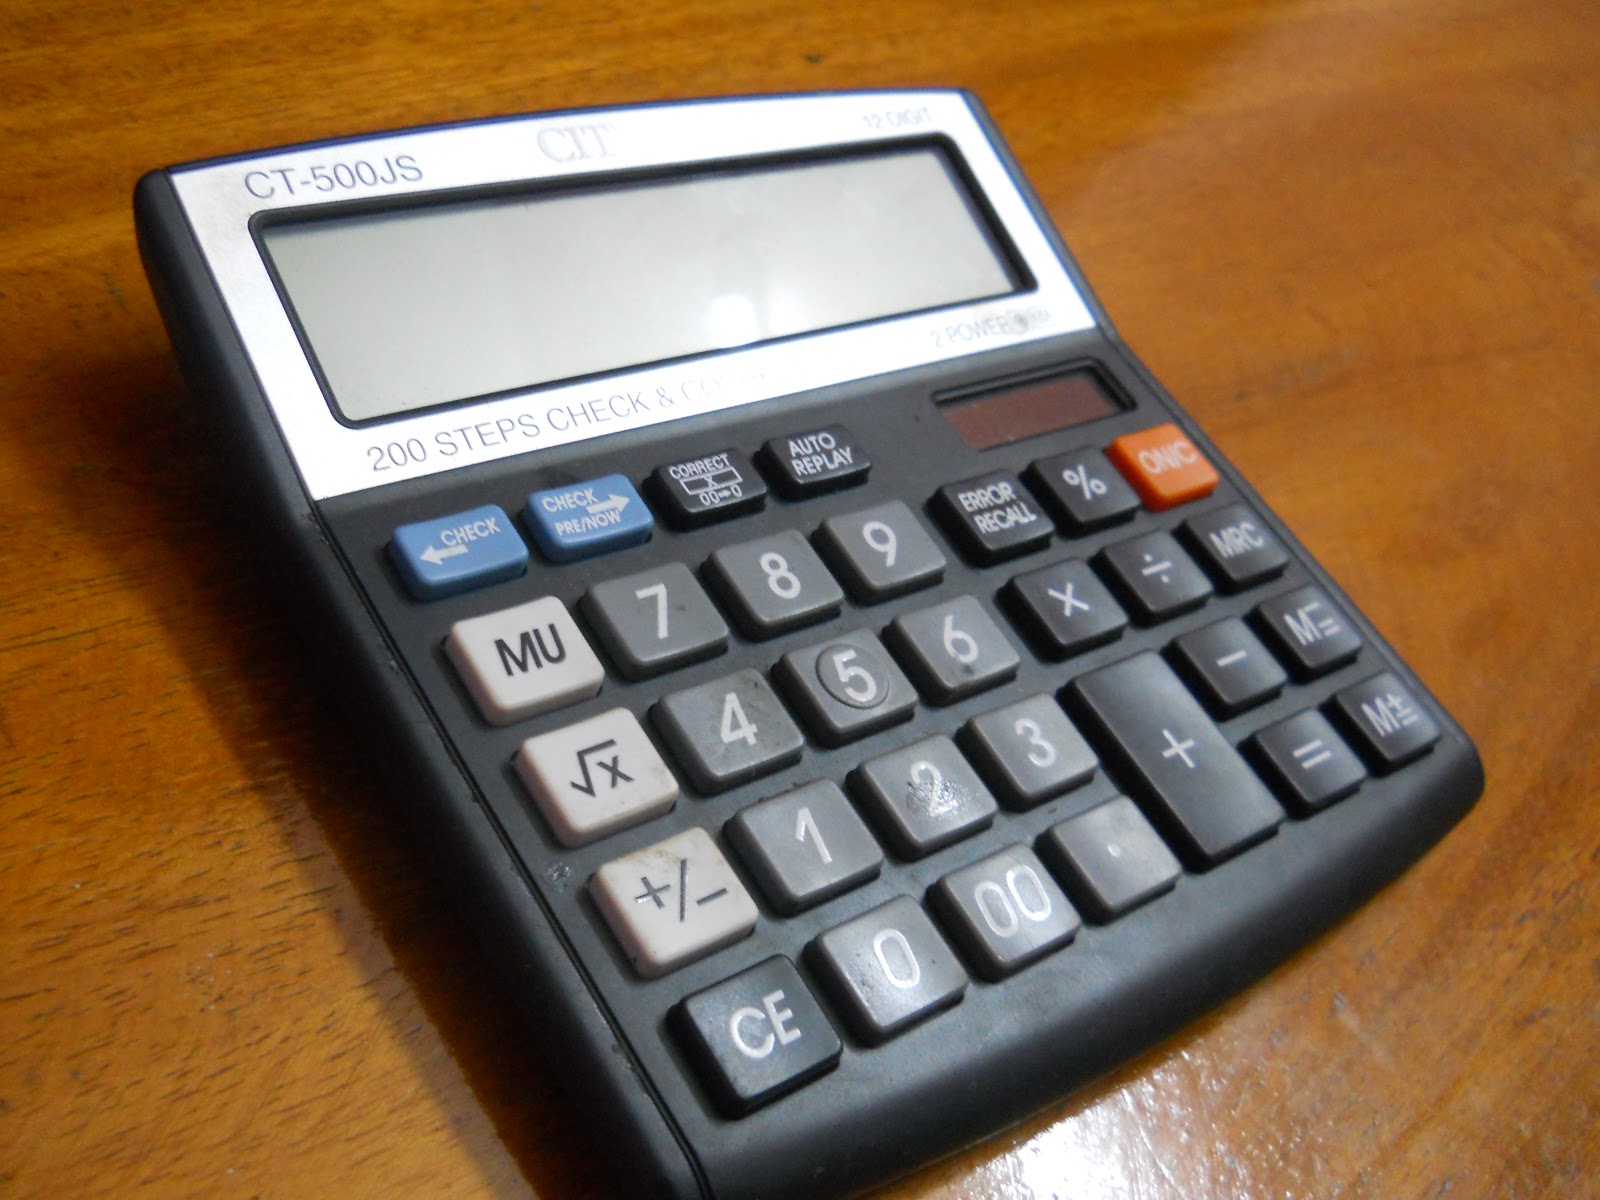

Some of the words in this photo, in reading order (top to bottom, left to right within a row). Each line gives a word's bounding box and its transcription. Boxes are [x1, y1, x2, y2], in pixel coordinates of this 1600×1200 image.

[537, 123, 614, 163] CIT
[245, 154, 423, 199] CT-500JS
[366, 437, 429, 473] 200
[434, 413, 542, 457] STEPS
[546, 395, 652, 432] CHECK
[656, 385, 676, 407] &
[787, 431, 836, 459] AUTO
[668, 452, 731, 480] CORRECT
[791, 446, 856, 478] REPLAY
[1062, 464, 1108, 500] %
[541, 487, 599, 514] CHECK
[957, 481, 1017, 514] ERROR
[973, 502, 1037, 535] RECALL
[440, 516, 501, 548] CHECK
[554, 508, 622, 537] PRE/NOW
[861, 520, 898, 568] 9
[1209, 521, 1265, 559] MRC
[759, 551, 802, 600] 8
[635, 582, 670, 640] 7
[493, 622, 568, 679] MU
[942, 614, 980, 664] 6
[832, 648, 878, 703] 5
[719, 691, 758, 747] 4
[1012, 717, 1058, 769] 3
[909, 759, 953, 818] 2
[794, 805, 834, 867] 1
[973, 863, 1053, 939] 00
[872, 927, 922, 991] 0
[727, 989, 802, 1061] CE
